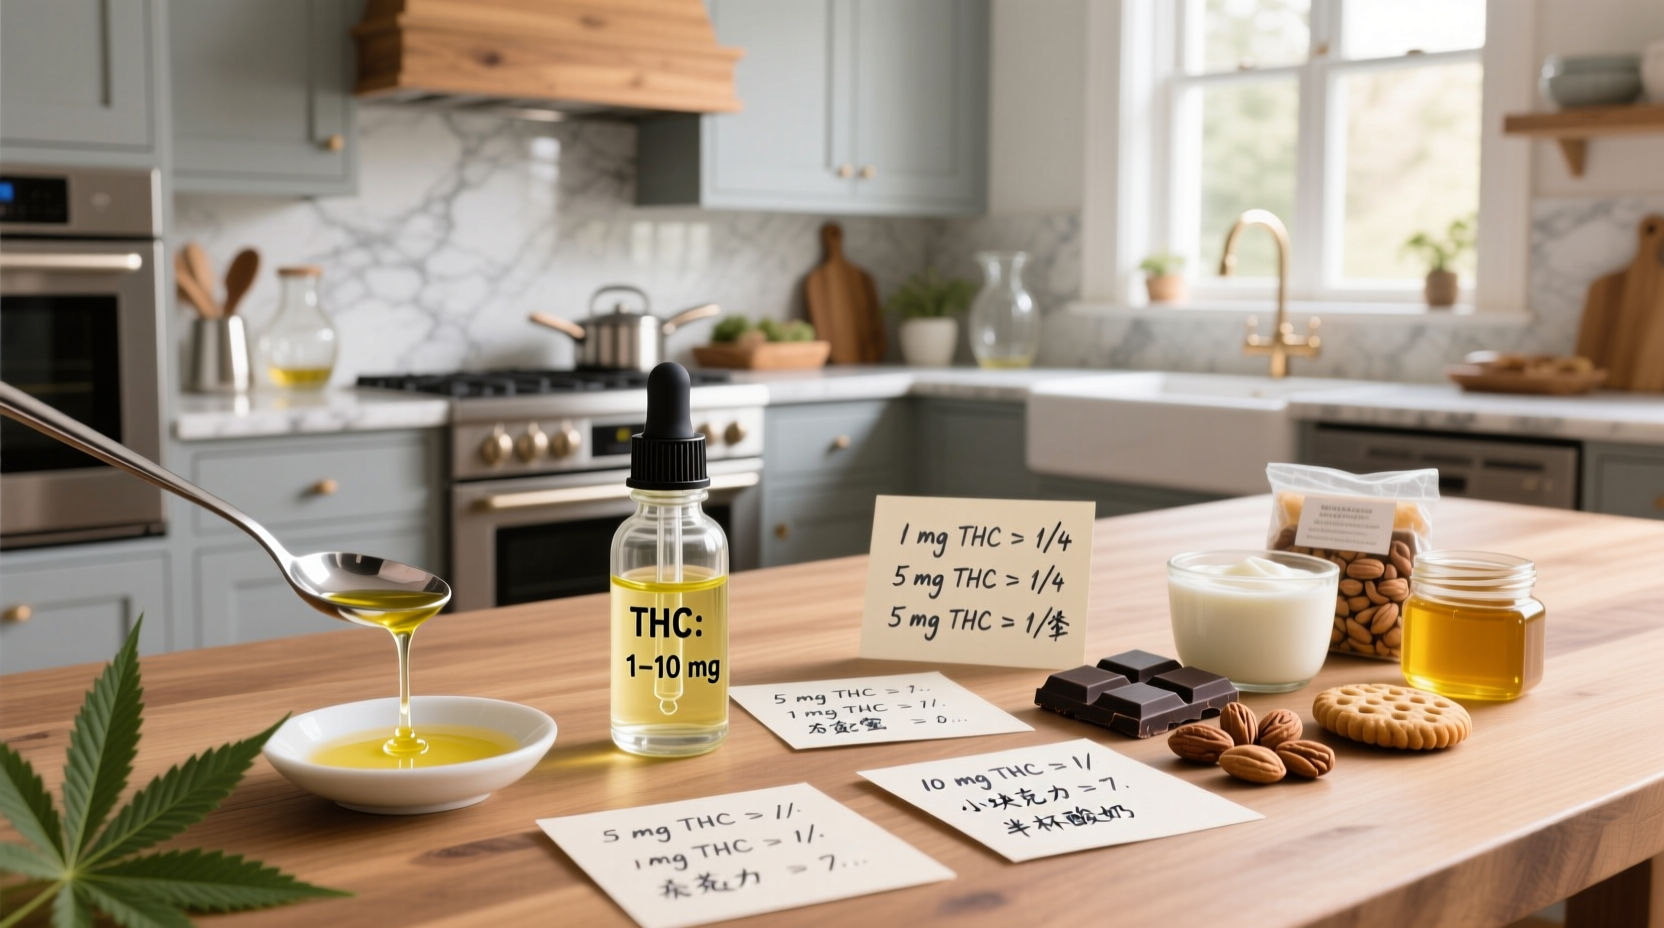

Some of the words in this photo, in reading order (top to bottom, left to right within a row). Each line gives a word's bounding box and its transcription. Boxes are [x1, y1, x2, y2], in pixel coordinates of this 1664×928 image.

[900, 522, 910, 546] 1
[916, 530, 949, 559] mg
[958, 525, 1002, 548] THC
[1036, 520, 1073, 554] 1/4
[892, 564, 911, 587] 5
[913, 573, 945, 600] mg
[953, 567, 997, 589] THC
[1030, 564, 1065, 595] 1/4
[629, 606, 703, 638] THC:
[887, 605, 907, 628] 5
[909, 613, 940, 642] mg
[949, 608, 992, 631] THC
[688, 659, 720, 684] mg
[774, 693, 787, 705] 5
[796, 694, 827, 706] mg
[831, 687, 877, 699] THC
[804, 709, 838, 720] mg
[842, 703, 888, 714] THC
[921, 778, 946, 793] 10
[953, 772, 993, 791] mg
[987, 762, 1045, 780] THC
[602, 828, 620, 844] 5
[632, 825, 672, 844] mg
[676, 812, 737, 832] THC
[633, 859, 642, 871] 1
[648, 851, 689, 872] mg
[690, 838, 754, 859] THC
